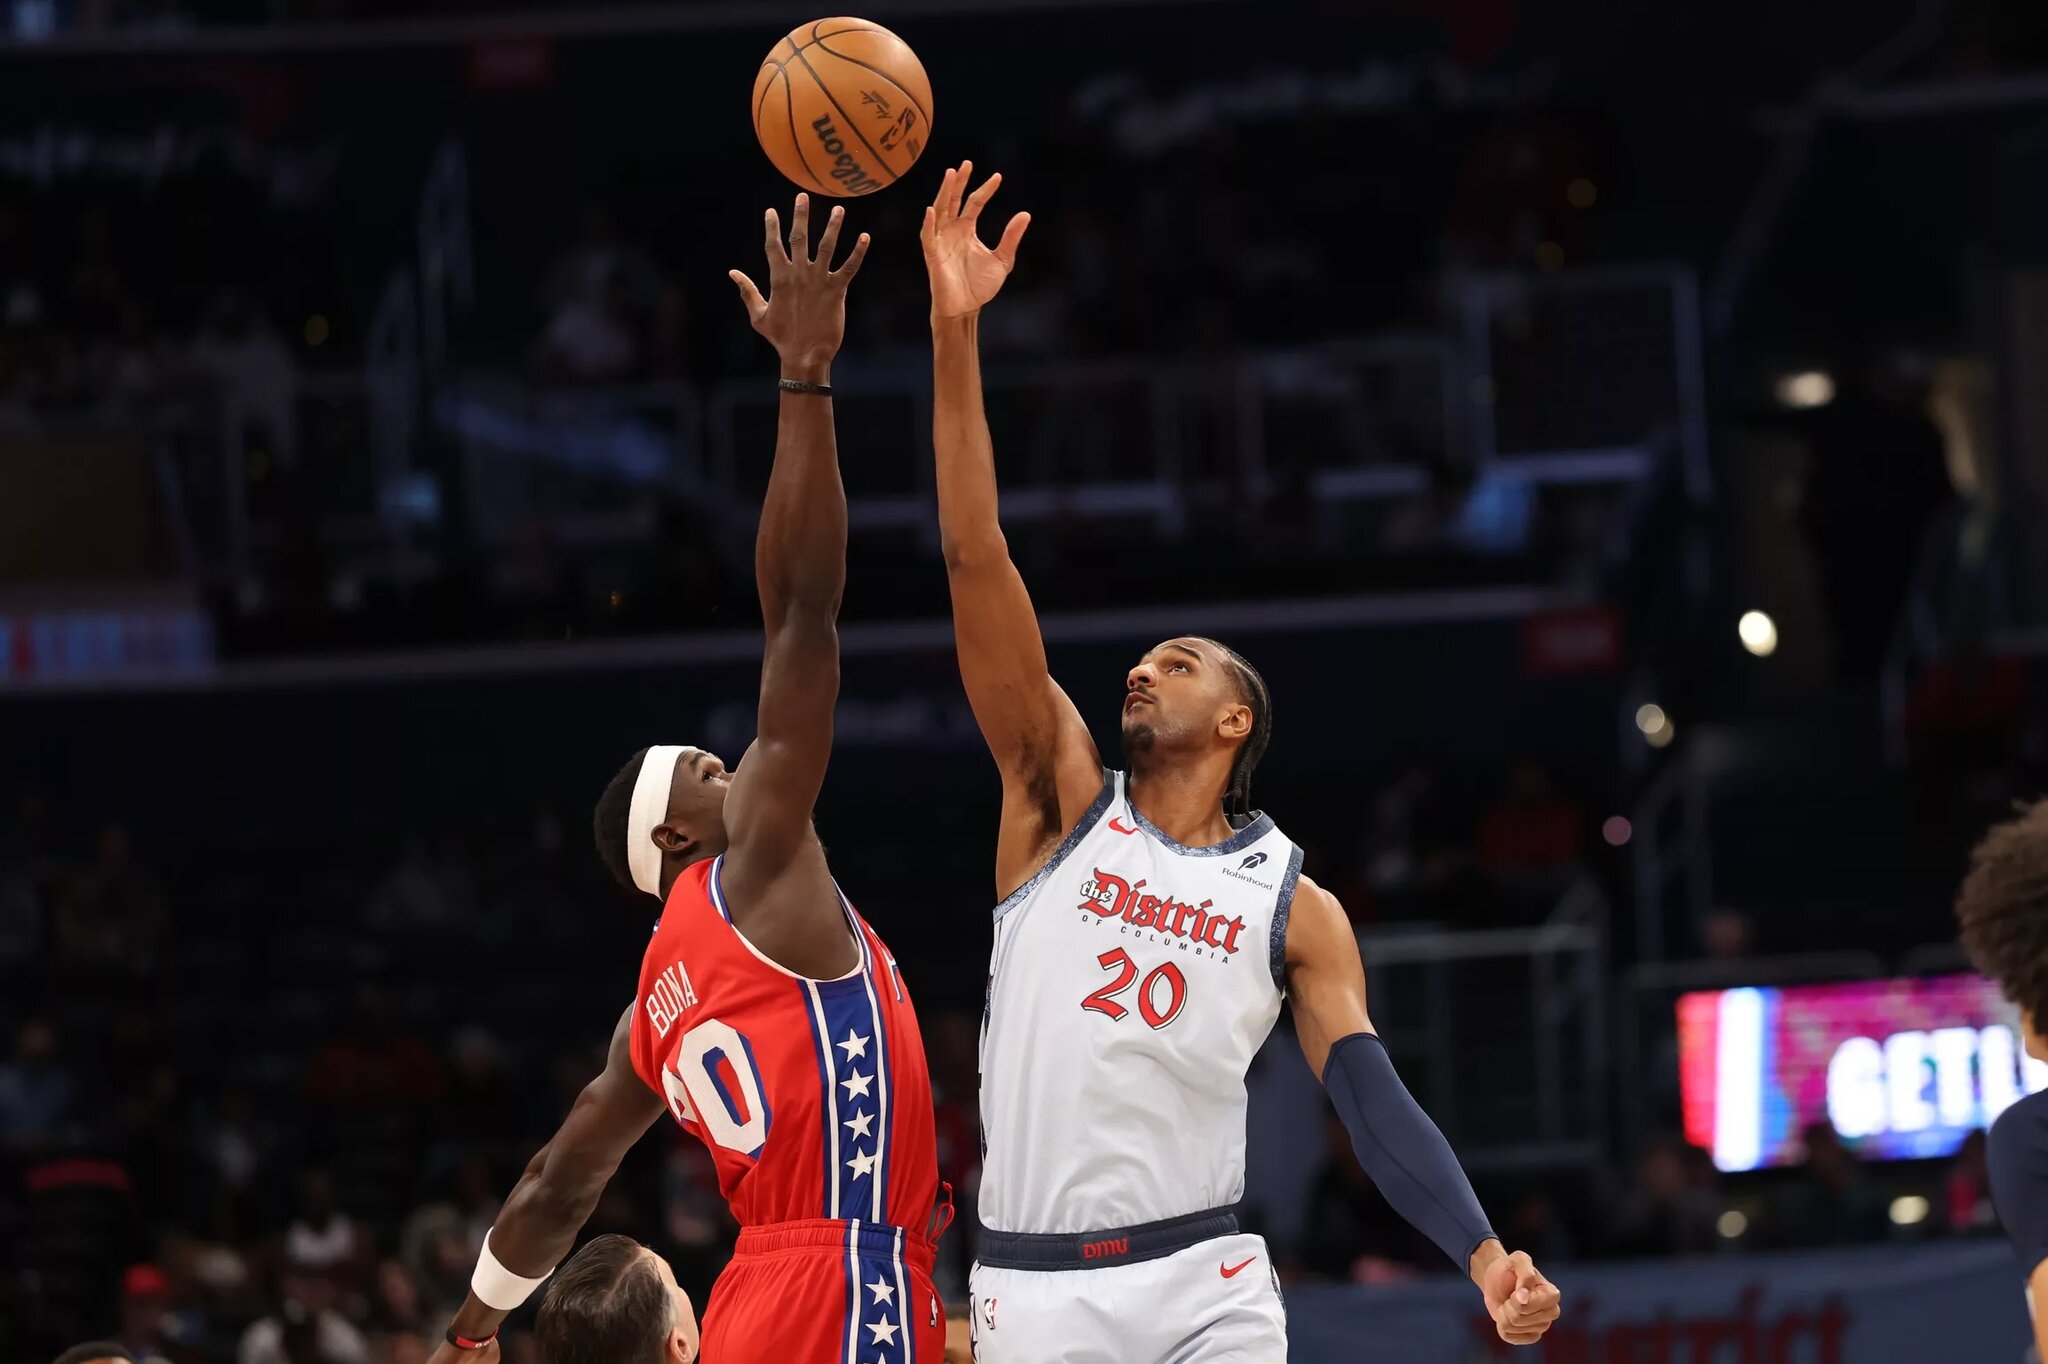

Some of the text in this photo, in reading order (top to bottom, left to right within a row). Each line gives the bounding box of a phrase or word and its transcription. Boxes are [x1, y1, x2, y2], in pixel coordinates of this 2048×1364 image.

[1078, 867, 1246, 954] District
[1080, 880, 1112, 902] the
[1222, 867, 1273, 891] Robinhood
[1082, 915, 1229, 964] OF COLUMBIA
[645, 961, 698, 1039] BONA
[1081, 947, 1188, 1030] 20
